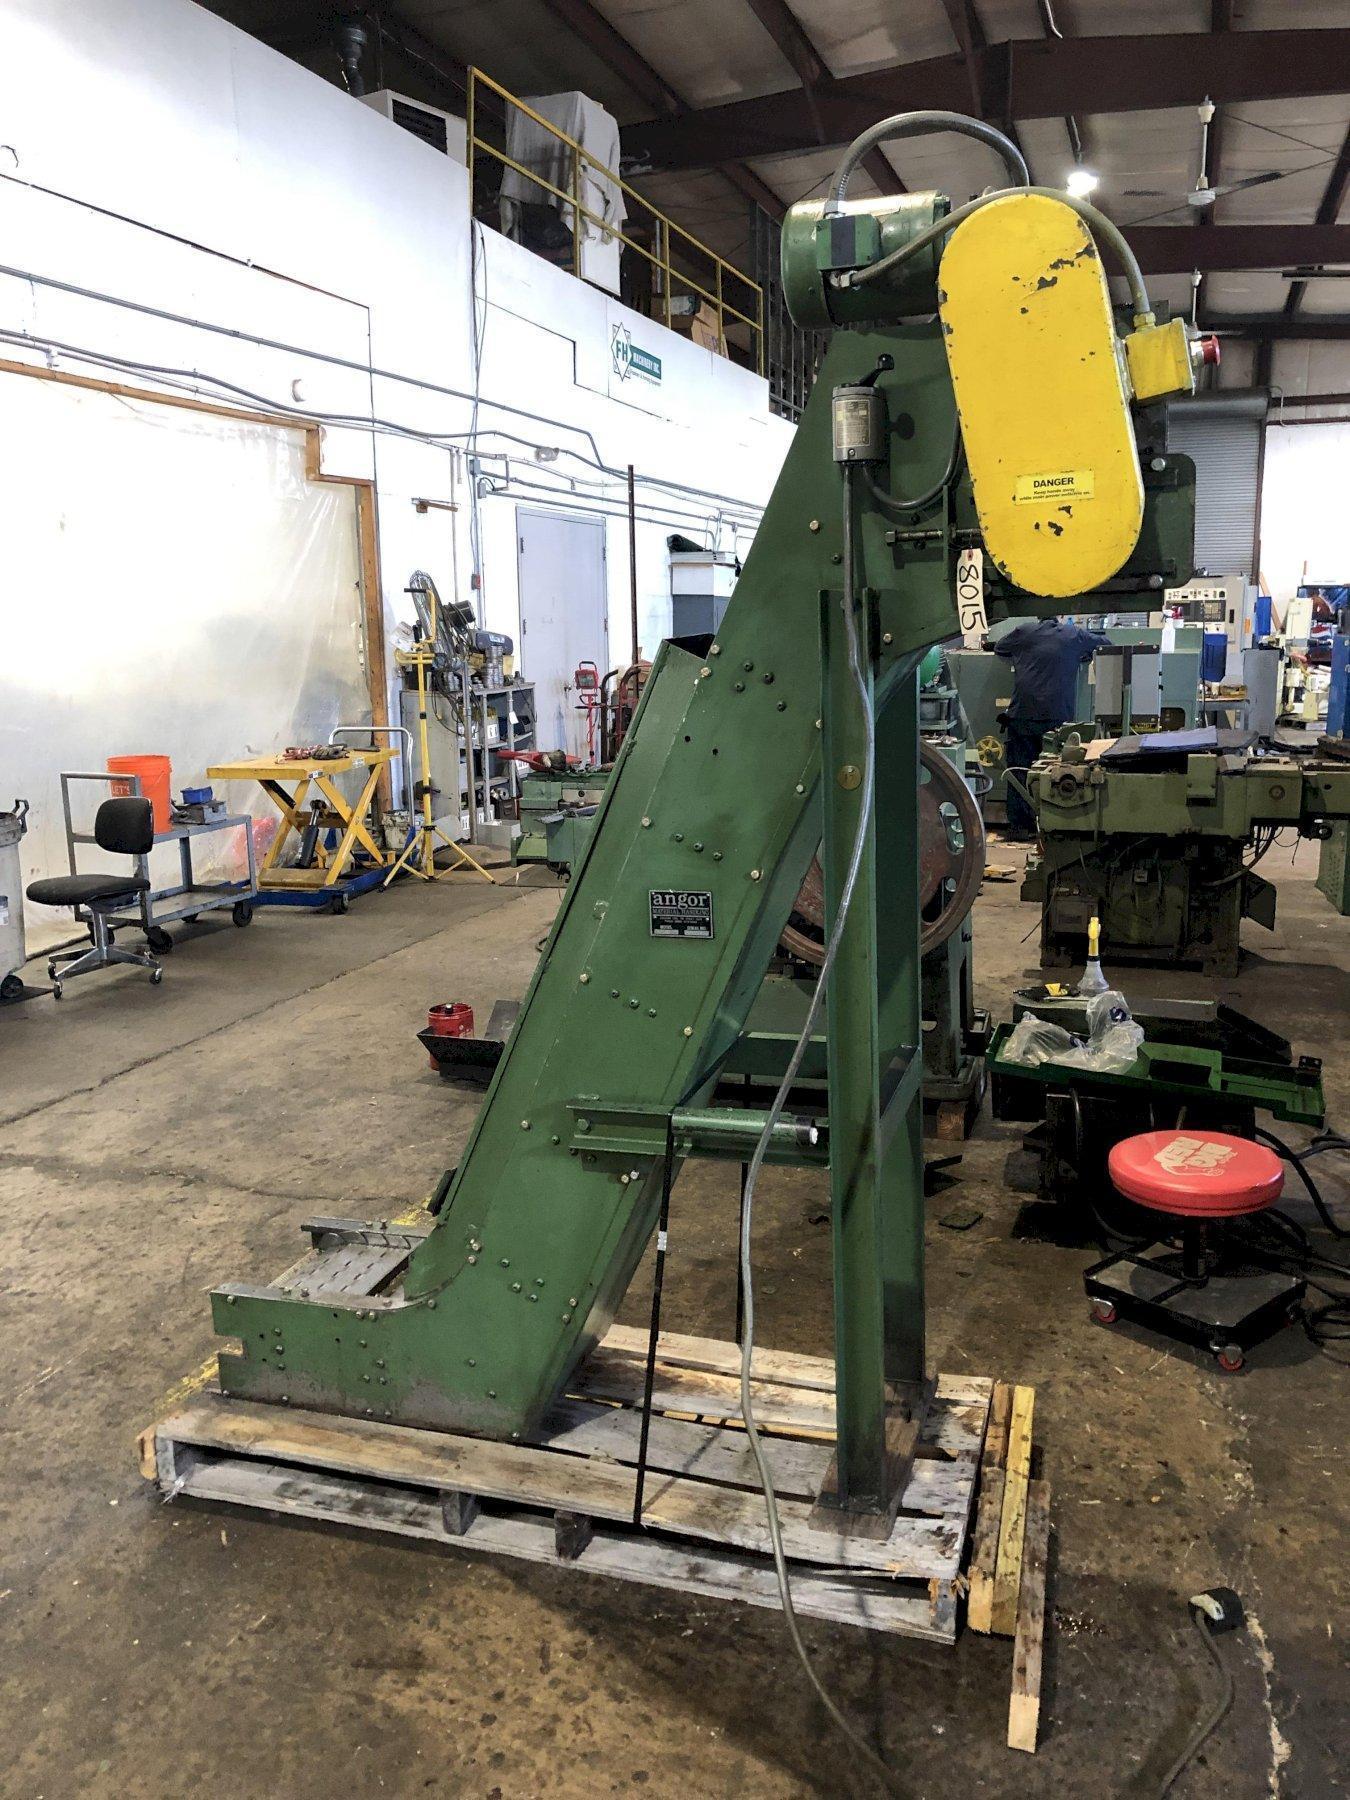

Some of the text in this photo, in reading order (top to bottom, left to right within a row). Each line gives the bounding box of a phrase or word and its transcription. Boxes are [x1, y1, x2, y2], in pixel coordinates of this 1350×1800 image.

[616, 339, 628, 362] FH
[1033, 477, 1074, 488] DANGER
[959, 564, 986, 630] 8015
[653, 893, 707, 910] angor
[652, 908, 679, 916] MATERIAL
